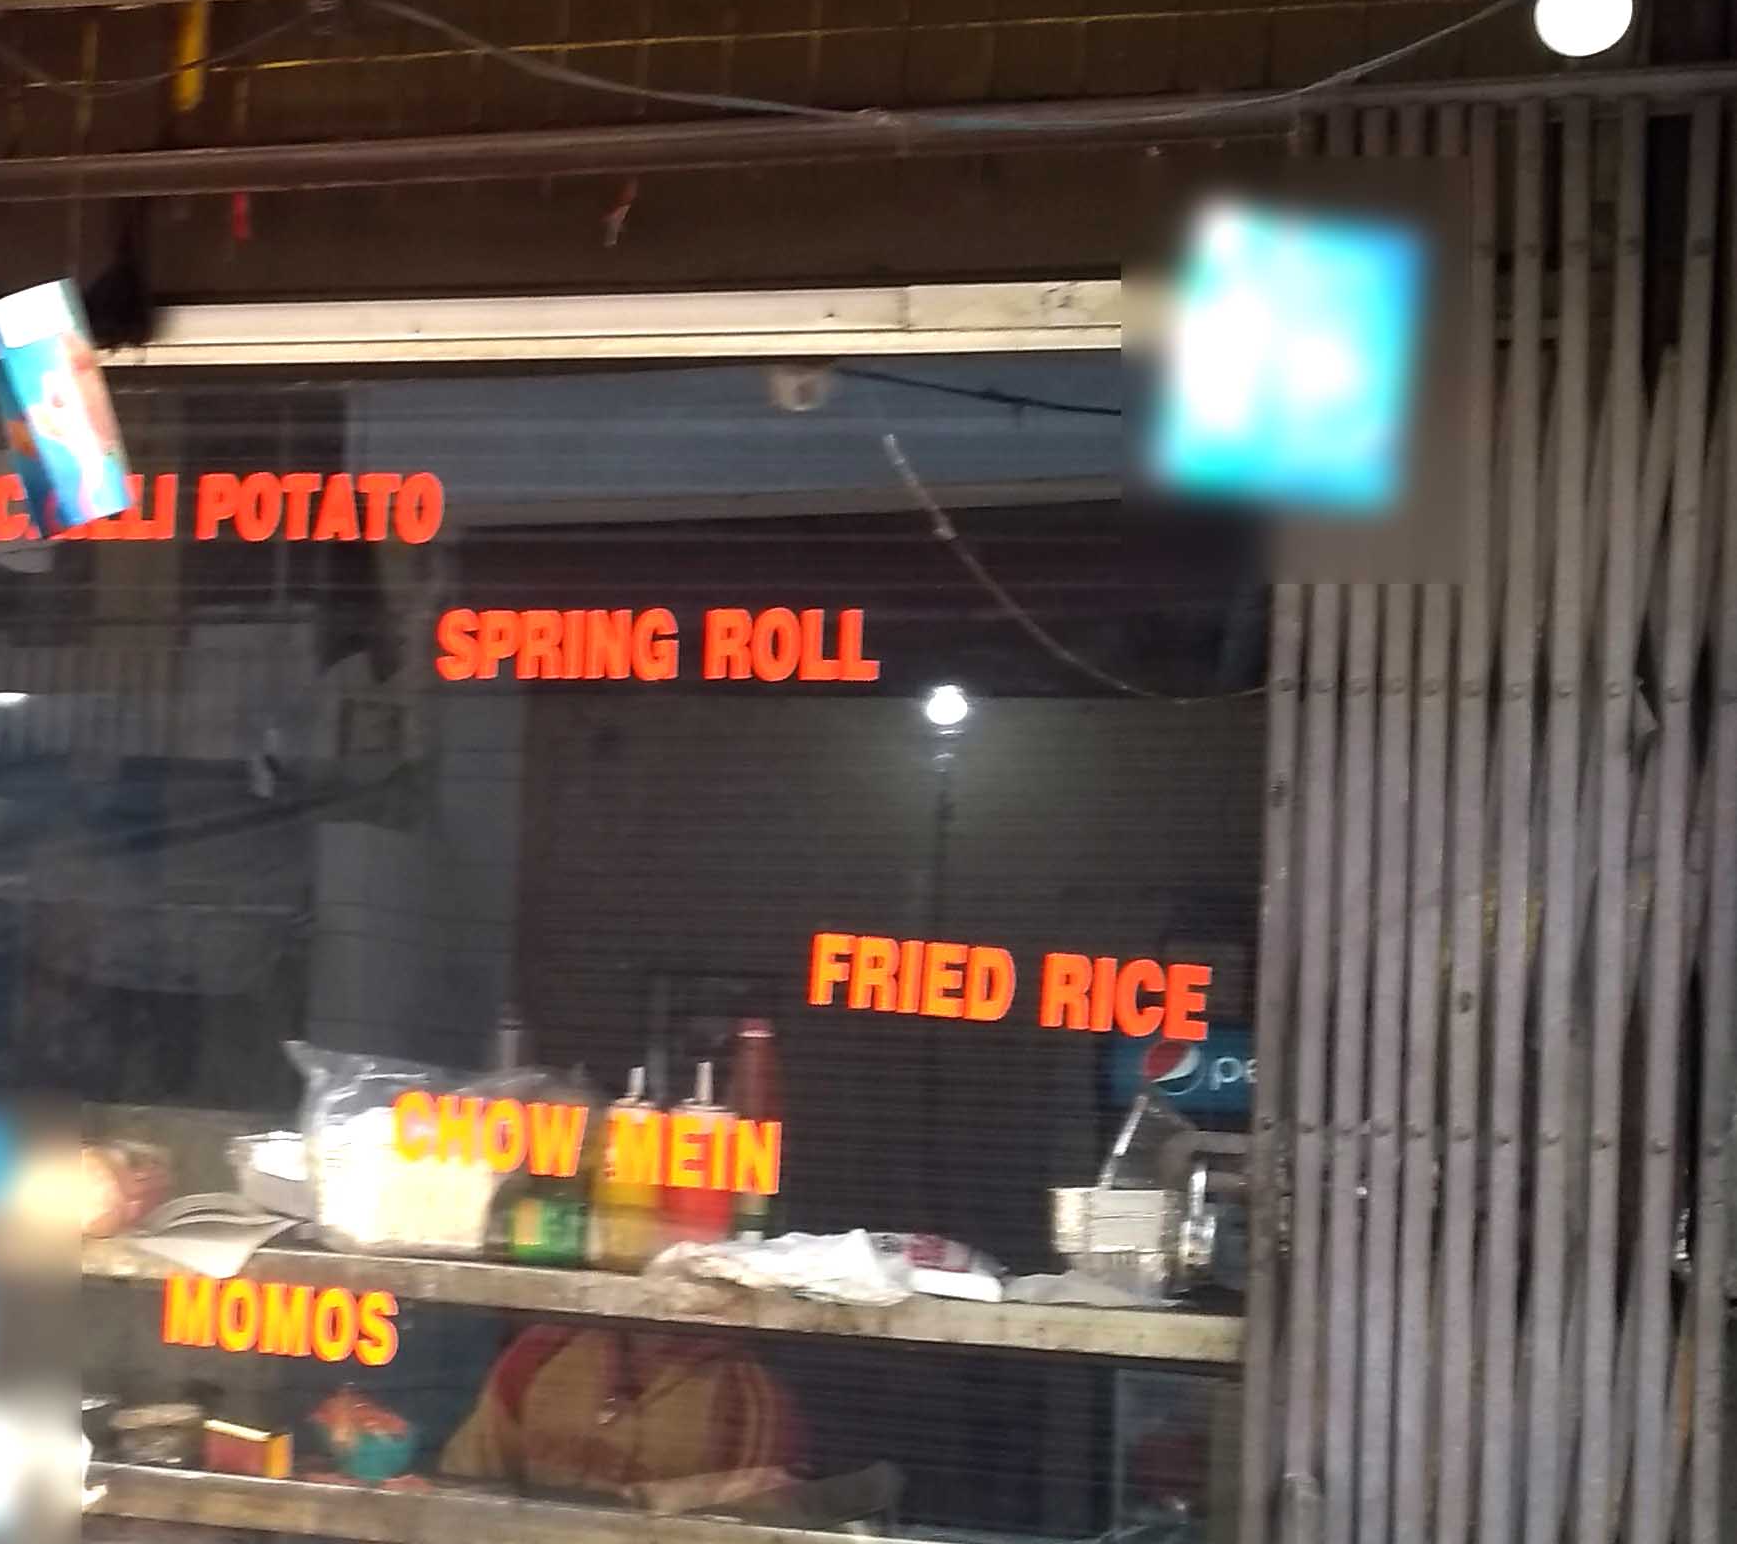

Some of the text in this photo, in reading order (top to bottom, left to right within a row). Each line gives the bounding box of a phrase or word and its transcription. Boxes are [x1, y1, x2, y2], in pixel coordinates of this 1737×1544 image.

[194, 470, 445, 545] POTATO
[435, 606, 881, 683] SPRING ROLL
[807, 932, 1213, 1042] FRIED RICE
[391, 1090, 783, 1196] CHOW MEIN
[161, 1272, 400, 1367] MOMOS
